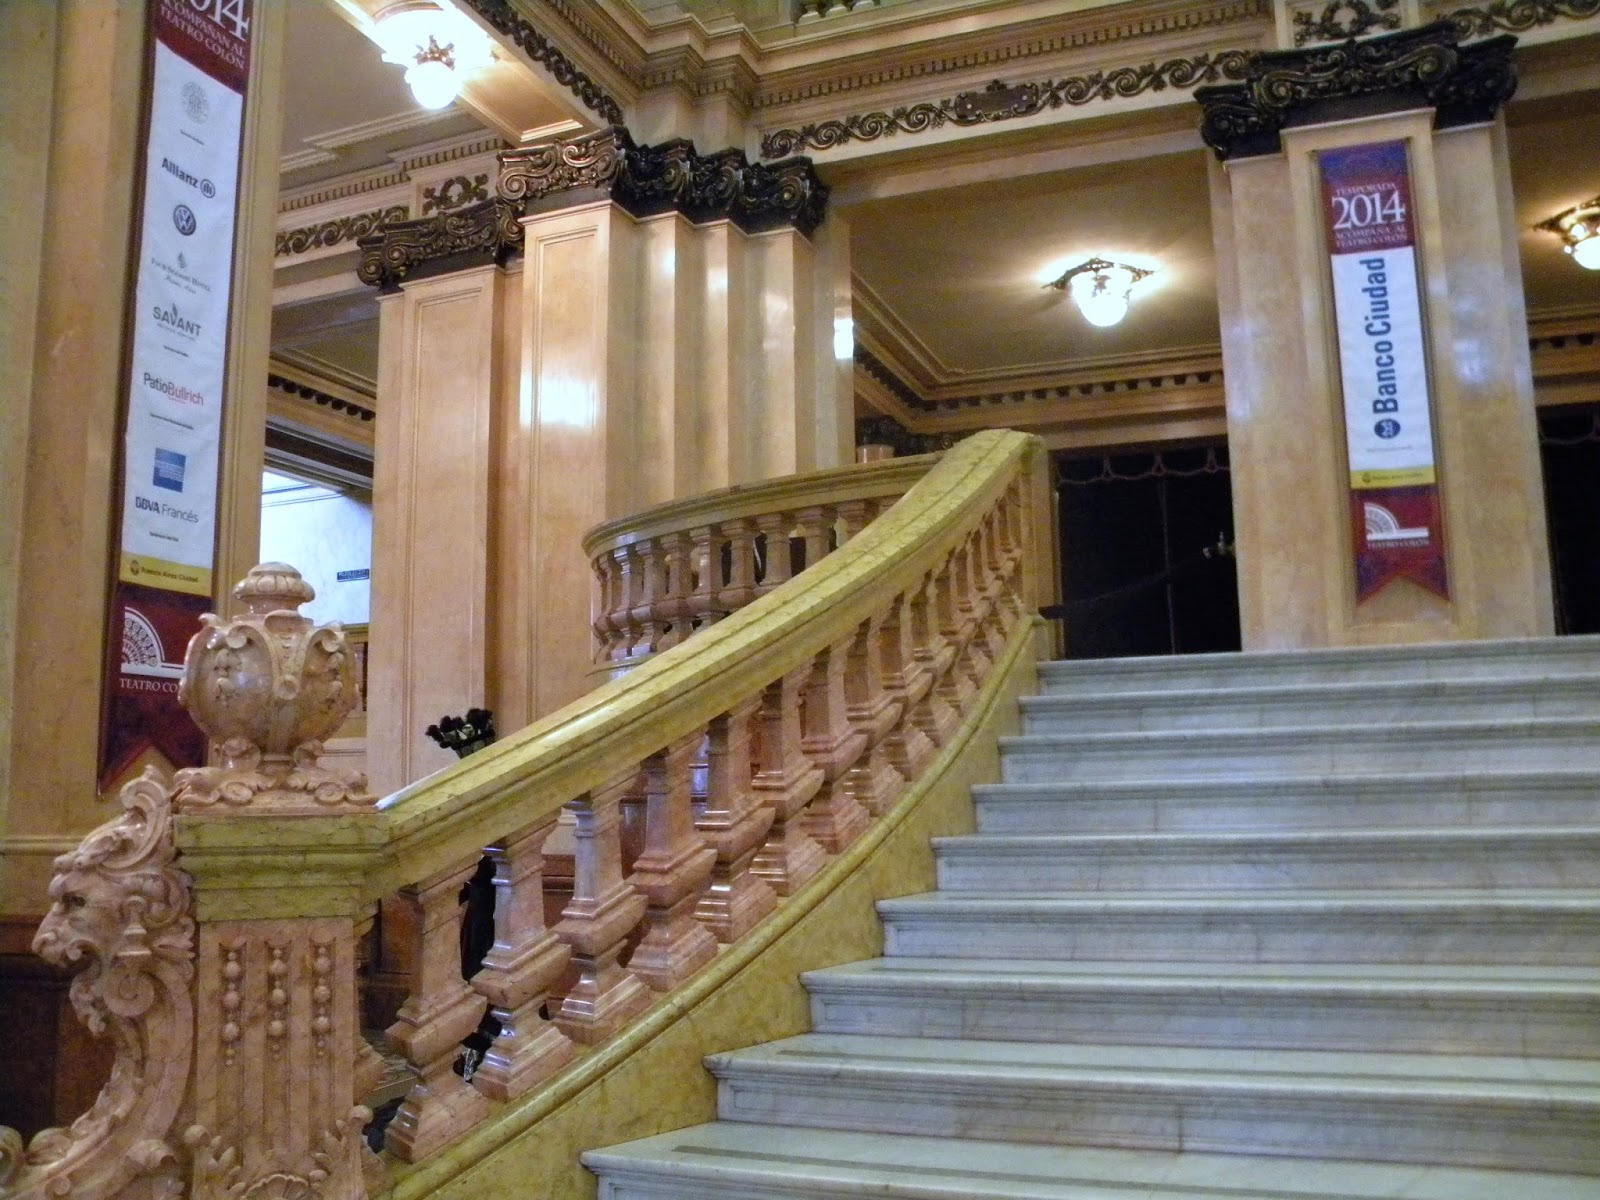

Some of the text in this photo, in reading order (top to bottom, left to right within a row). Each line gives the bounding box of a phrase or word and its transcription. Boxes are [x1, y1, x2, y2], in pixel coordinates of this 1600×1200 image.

[160, 5, 204, 42] TEATRO
[161, 157, 199, 189] Allianz
[1331, 190, 1406, 230] 2014
[1359, 256, 1392, 337] Ciudad
[152, 305, 202, 337] SAVANT
[1372, 340, 1399, 414] Banco
[135, 496, 199, 523] BBVA Francés
[119, 678, 161, 692] TEATRO
